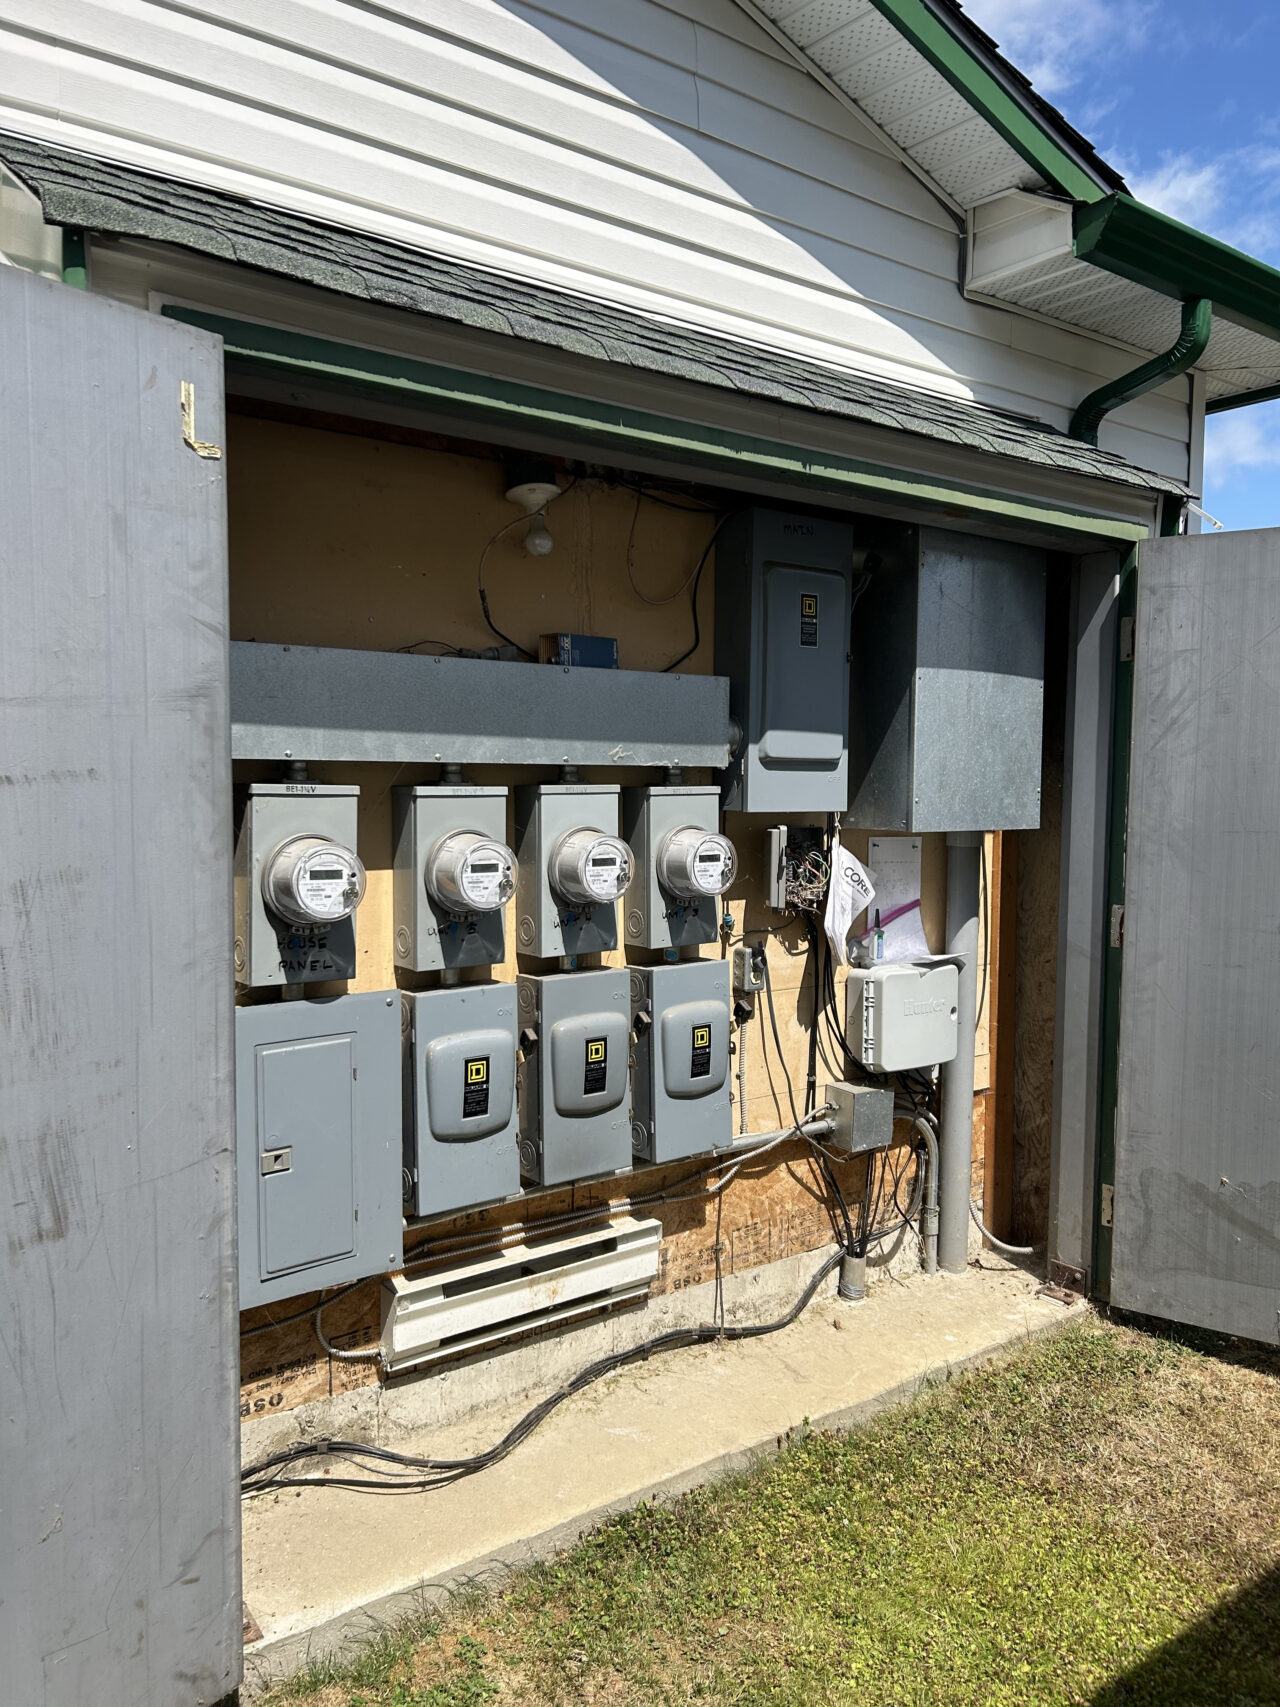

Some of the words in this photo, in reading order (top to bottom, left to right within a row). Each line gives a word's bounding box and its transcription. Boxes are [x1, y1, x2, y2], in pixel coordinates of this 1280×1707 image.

[783, 522, 816, 537] MAIN
[844, 866, 871, 897] CORE
[278, 936, 328, 950] HOUSE
[278, 960, 334, 973] PANEL
